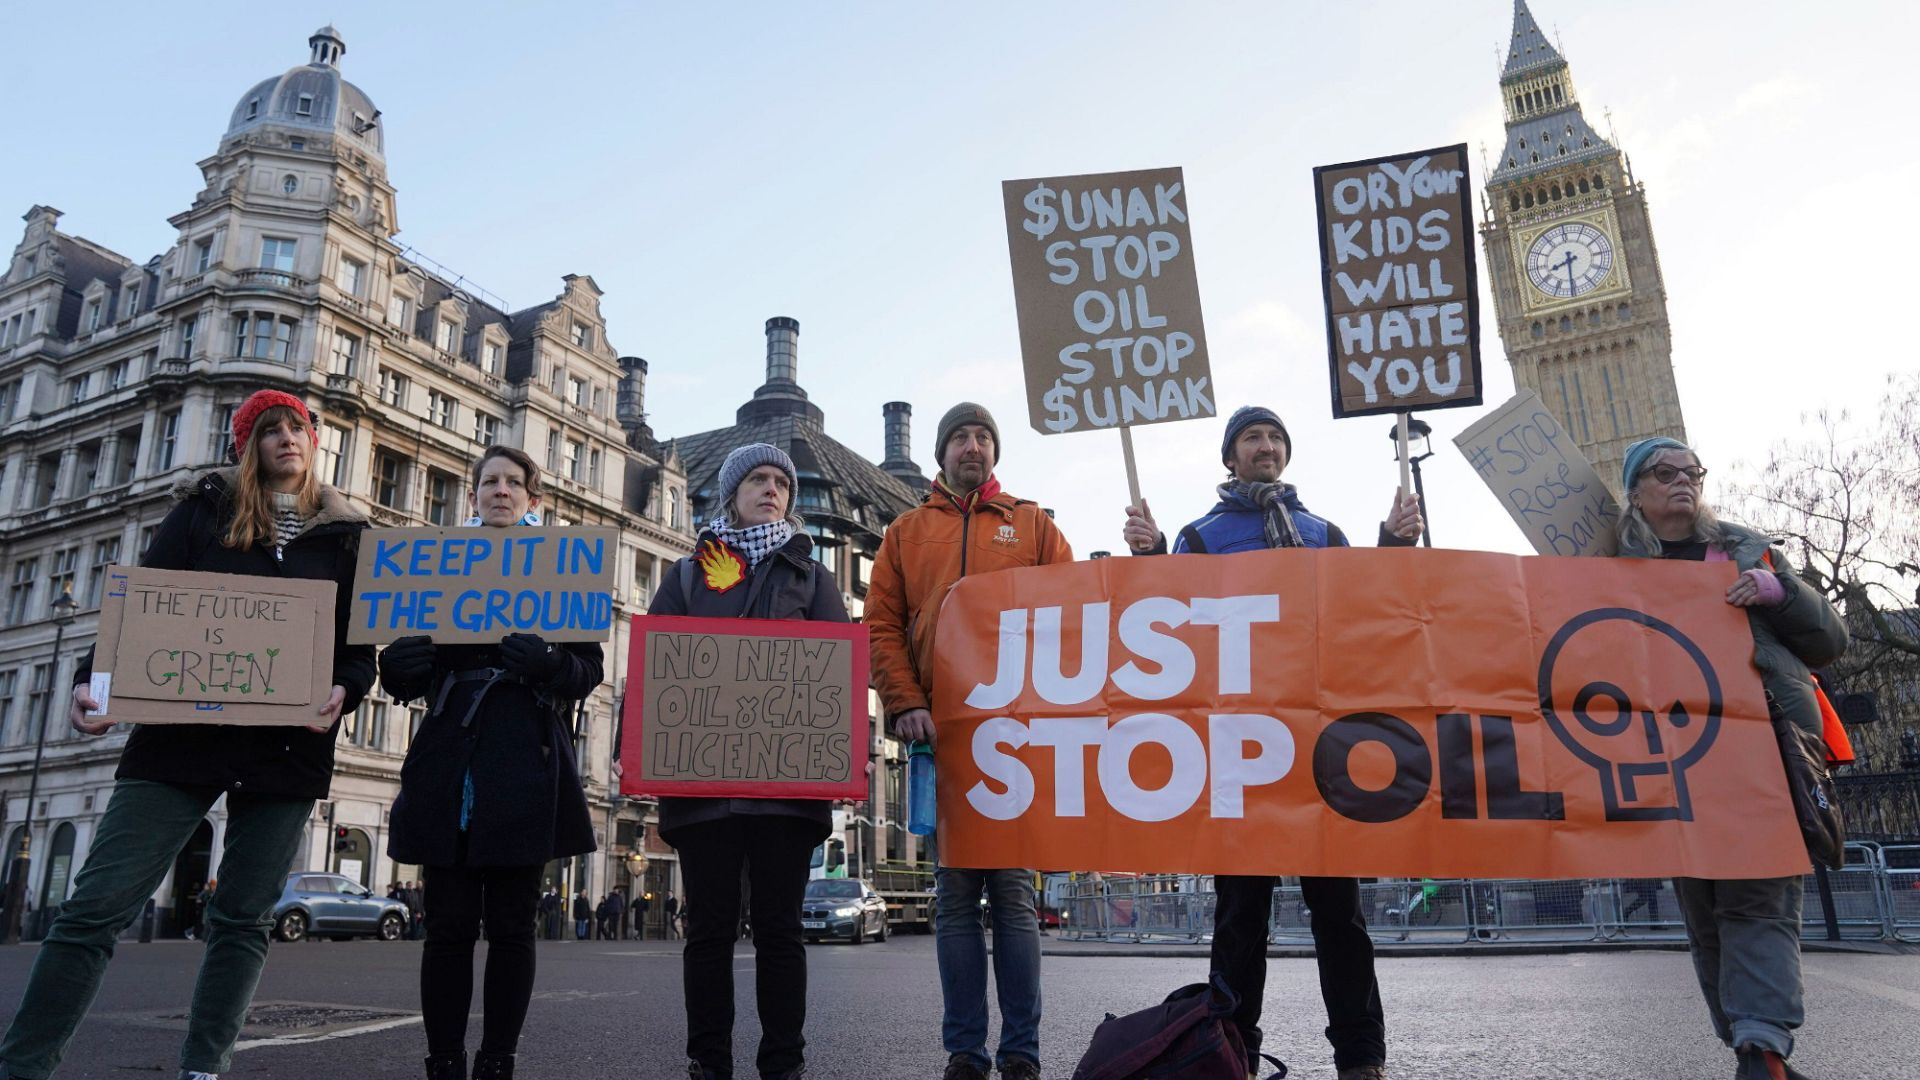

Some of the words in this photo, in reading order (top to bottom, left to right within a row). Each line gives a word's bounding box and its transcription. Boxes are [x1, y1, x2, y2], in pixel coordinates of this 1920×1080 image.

[1023, 181, 1187, 241] $UNAK
[1332, 171, 1395, 215] OR
[1045, 230, 1181, 286] STOP
[1331, 208, 1451, 265] KIDS
[1335, 258, 1454, 307] WILL
[1073, 284, 1168, 335] OIL
[1338, 302, 1468, 356] HATE
[1058, 331, 1196, 385] STOP
[1347, 351, 1462, 404] YOU
[1042, 376, 1216, 434] $UNAK
[1543, 494, 1619, 557] Bank
[373, 538, 492, 578] KEEP
[501, 536, 545, 577] IT
[556, 537, 604, 576] IN
[134, 590, 189, 617] THE
[195, 594, 288, 622] FUTURE
[359, 590, 444, 630] THE
[452, 588, 613, 633] GROUND
[205, 627, 225, 645] IS
[653, 633, 720, 680] NO
[735, 638, 837, 683] NEW
[964, 594, 1280, 710] JUST
[146, 648, 280, 696] GREEN
[657, 685, 729, 728] OIL
[761, 683, 842, 730] GAS
[653, 731, 851, 783] LICENCES
[965, 712, 1296, 822] STOP
[1312, 711, 1566, 824] OIL
